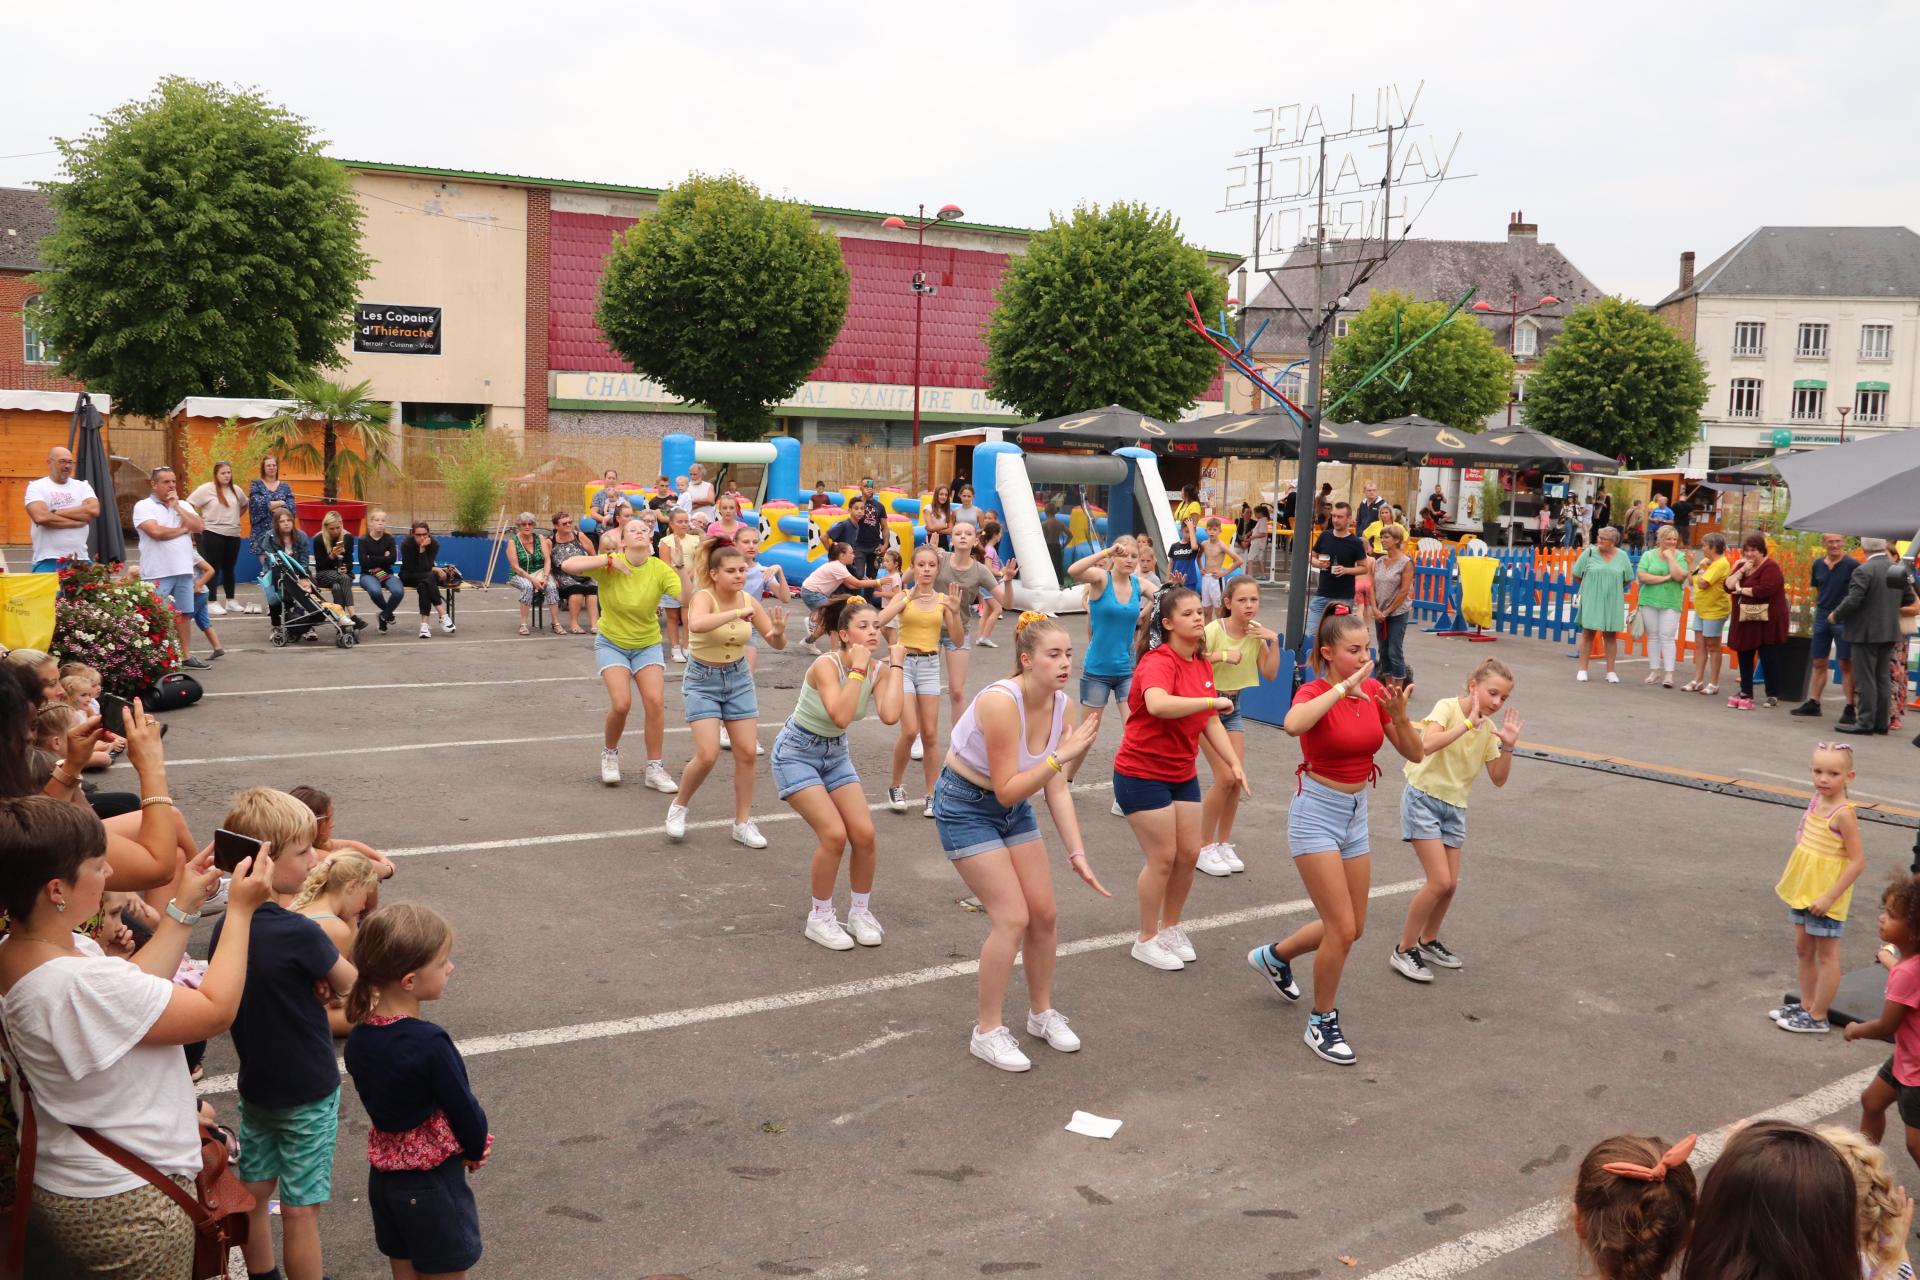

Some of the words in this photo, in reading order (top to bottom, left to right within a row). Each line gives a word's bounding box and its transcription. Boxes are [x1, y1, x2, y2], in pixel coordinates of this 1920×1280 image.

[363, 310, 382, 320] Les
[386, 311, 434, 324] Copains
[362, 325, 434, 338] d'Thiérache
